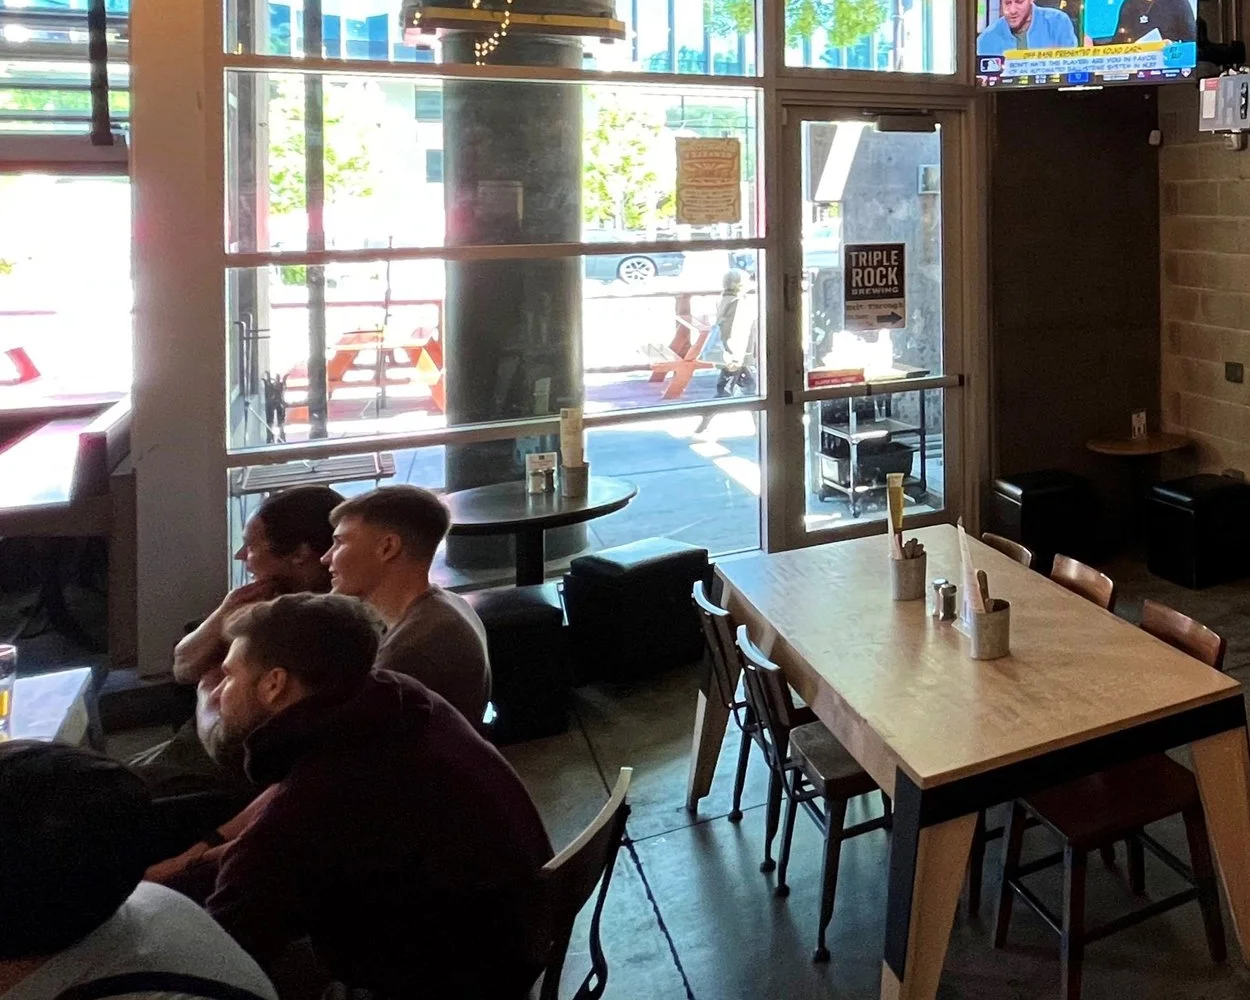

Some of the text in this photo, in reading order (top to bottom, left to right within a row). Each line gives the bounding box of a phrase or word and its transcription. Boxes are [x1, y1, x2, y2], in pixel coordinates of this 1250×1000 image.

[849, 250, 899, 267] TRIPLE
[852, 267, 898, 287] ROCK
[852, 286, 899, 295] BREWING
